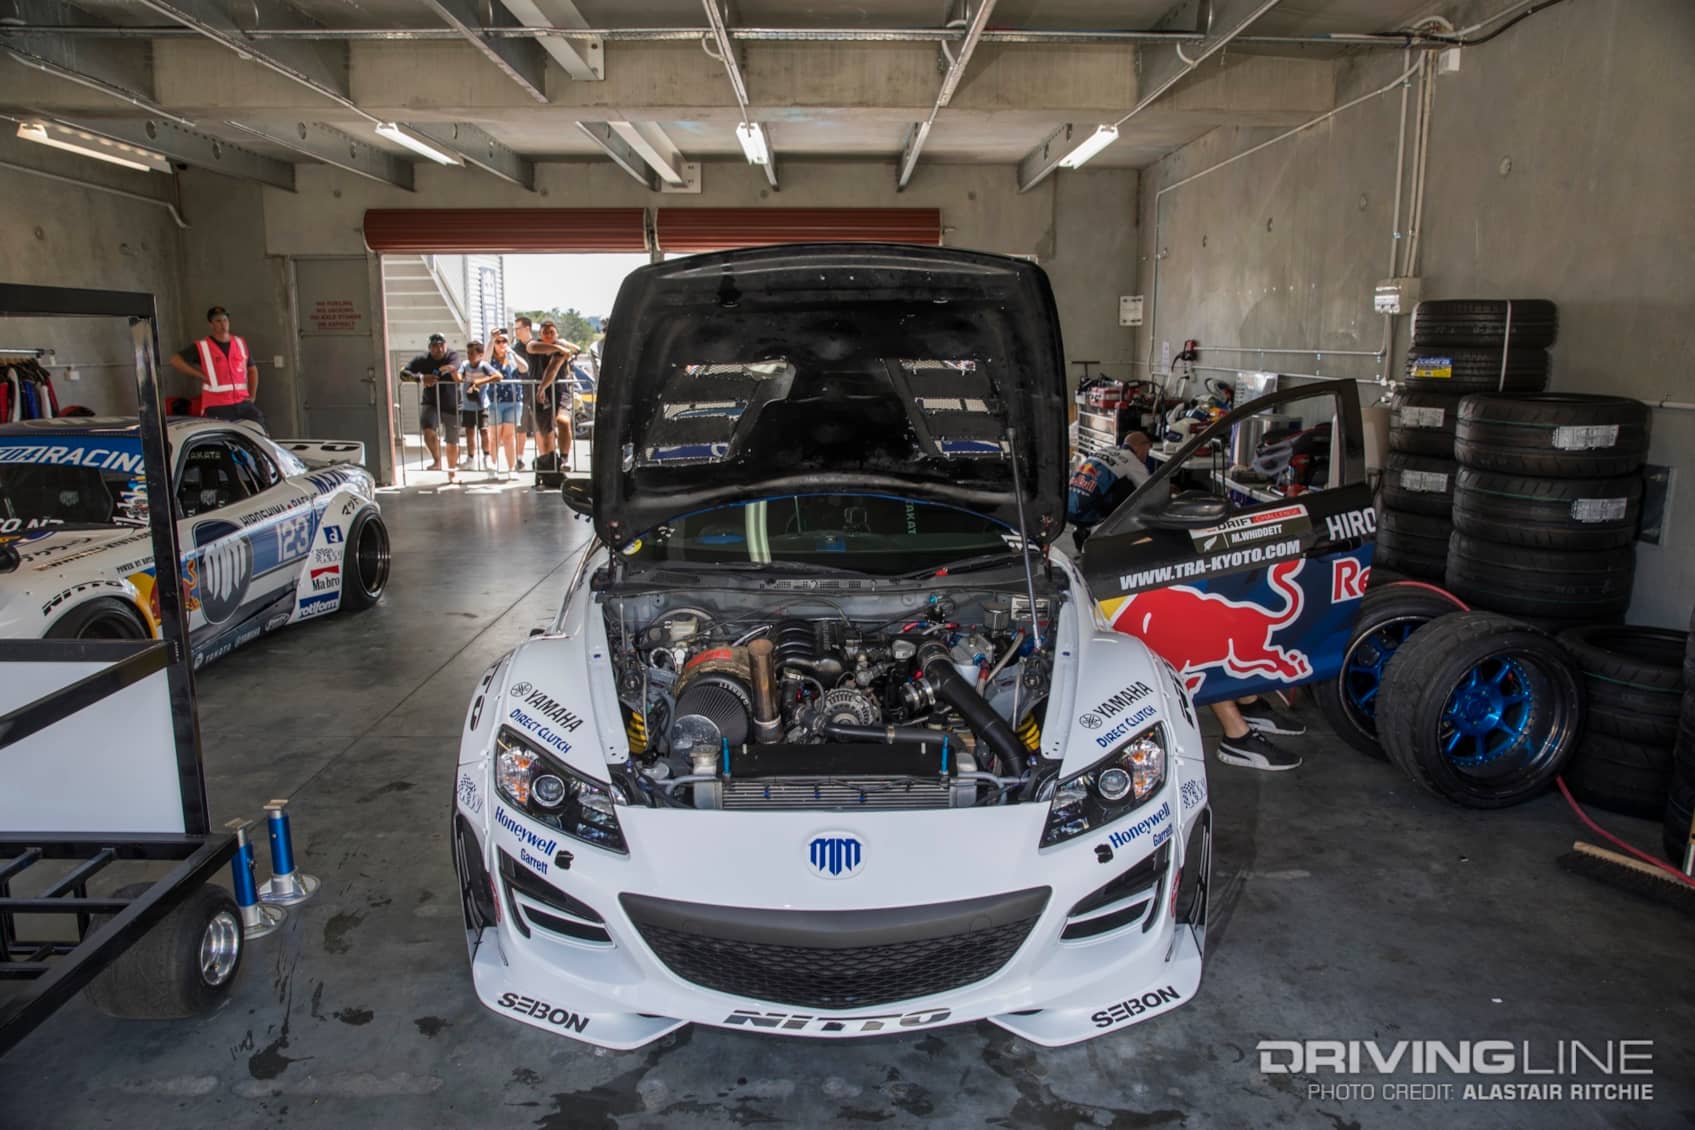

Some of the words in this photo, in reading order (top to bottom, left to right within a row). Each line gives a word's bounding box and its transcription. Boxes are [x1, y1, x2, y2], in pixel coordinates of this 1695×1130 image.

[277, 517, 309, 562] 123
[1231, 524, 1283, 544] M.WHIDDETT
[1120, 539, 1300, 591] WWW.TRA-KYOTO.COM
[524, 689, 584, 733] YAMAHA
[1094, 681, 1153, 719] YAMAHA
[495, 806, 557, 856] Honeywell
[1108, 801, 1171, 848] Honeywell
[1153, 824, 1174, 847] Garrett
[520, 848, 549, 875] Garrett
[496, 991, 590, 1034] SEBON
[722, 1008, 952, 1032] NITTO
[1091, 985, 1181, 1029] SEBON
